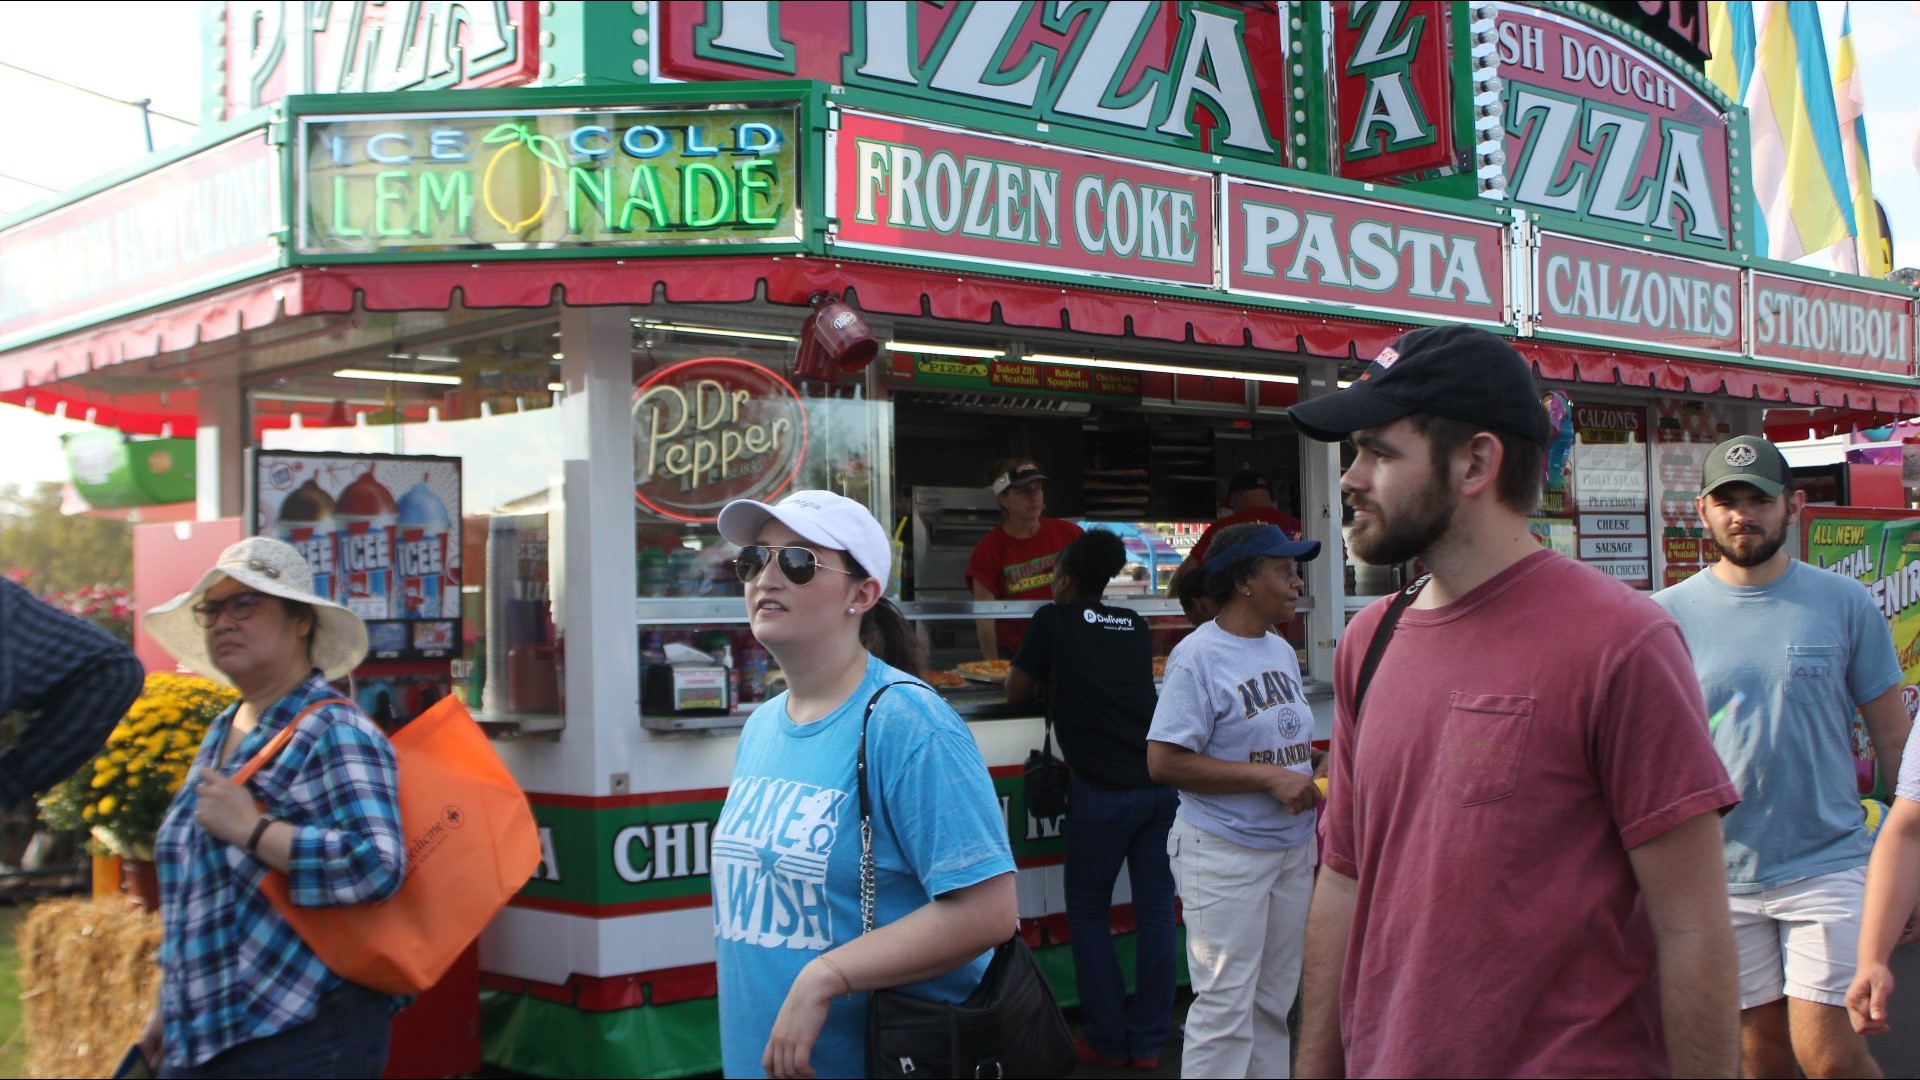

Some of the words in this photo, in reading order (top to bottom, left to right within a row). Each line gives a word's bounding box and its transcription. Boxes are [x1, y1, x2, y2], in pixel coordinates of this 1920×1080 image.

[1561, 34, 1676, 109] DOUGH
[331, 126, 472, 165] ICE
[569, 122, 784, 159] COLD
[855, 139, 1060, 247] FROZEN
[1073, 175, 1197, 264] COKE
[1241, 201, 1492, 304] PASTA
[1545, 254, 1735, 338] CALZONES
[1757, 288, 1909, 362] STROMBOLI
[930, 363, 980, 375] PIZZA
[996, 364, 1020, 375] Baked
[1002, 374, 1039, 386] Meatballs
[1054, 369, 1081, 380] Baked
[1047, 377, 1089, 391] Spaghetti
[696, 379, 750, 431] Dr
[1578, 408, 1639, 430] CALZONES
[631, 384, 790, 490] Pepper
[1583, 474, 1611, 487] PHILLY
[1613, 474, 1640, 487] STEAK
[1588, 495, 1636, 508] PEPPERONI
[1596, 519, 1630, 531] CHEESE
[1813, 525, 1834, 546] ALL
[1835, 524, 1865, 546] NEW!
[343, 532, 389, 573] ICEE
[396, 540, 441, 578] ICEE
[1595, 542, 1633, 554] SAUSAGE
[1615, 562, 1646, 576] CHICKEN
[1096, 613, 1133, 627] Delivery
[727, 862, 832, 943] WISH
